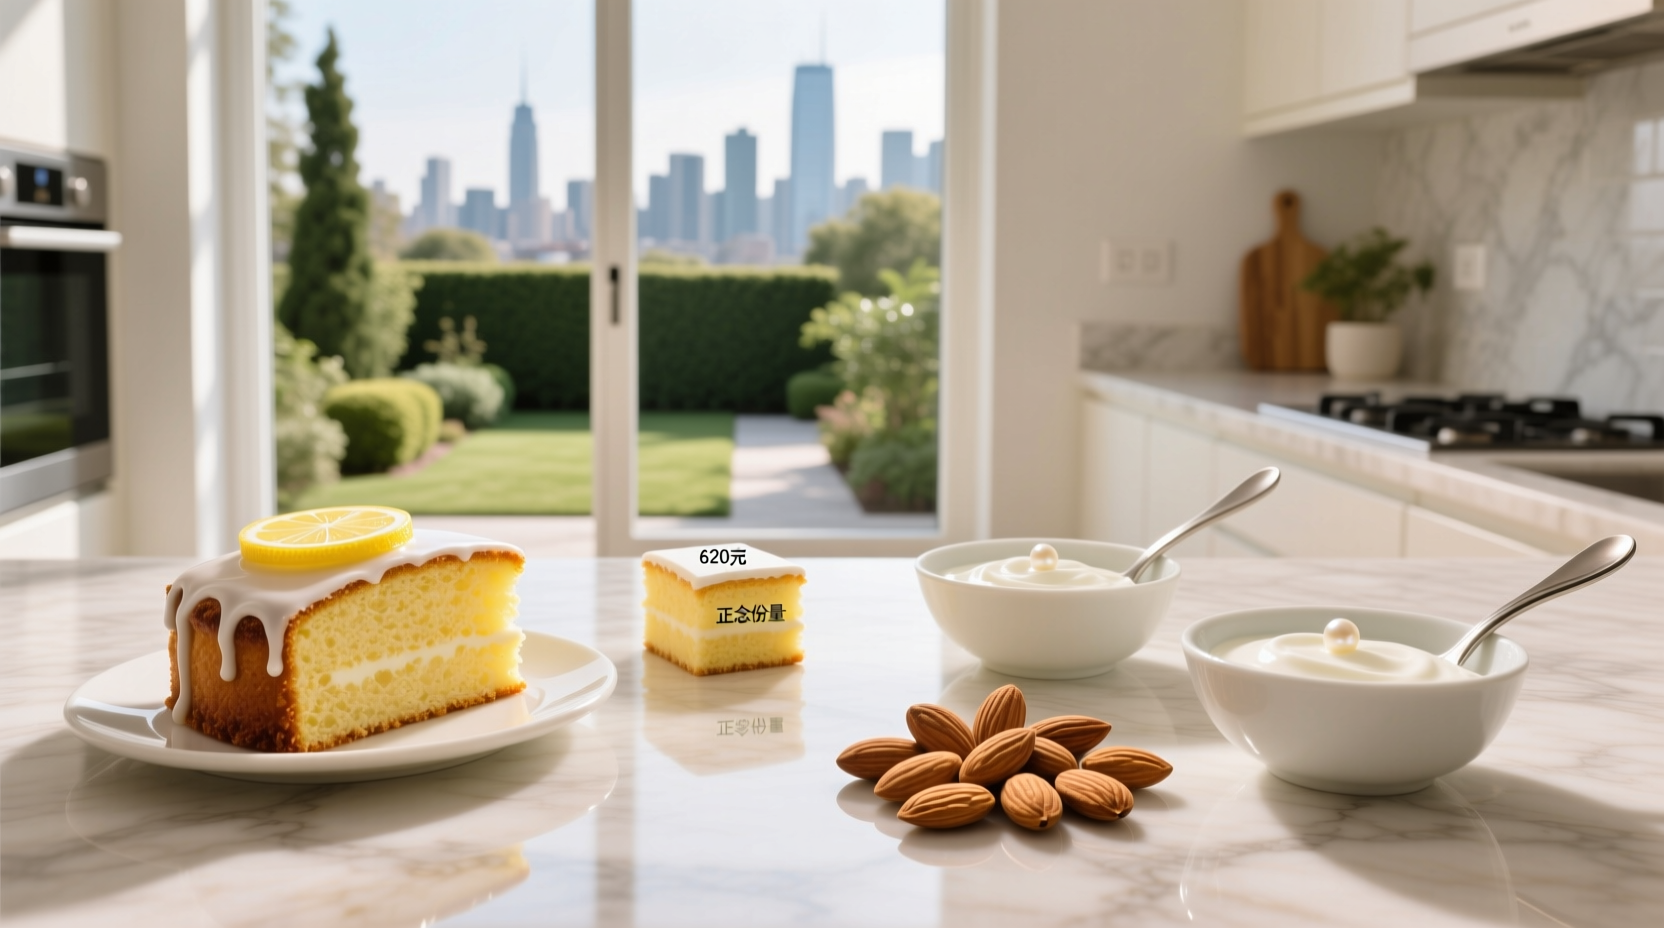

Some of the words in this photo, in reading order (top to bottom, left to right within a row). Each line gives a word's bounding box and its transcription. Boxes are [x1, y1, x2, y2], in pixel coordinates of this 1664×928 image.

[699, 548, 747, 566] 620元
[716, 604, 787, 624] 正念份量
